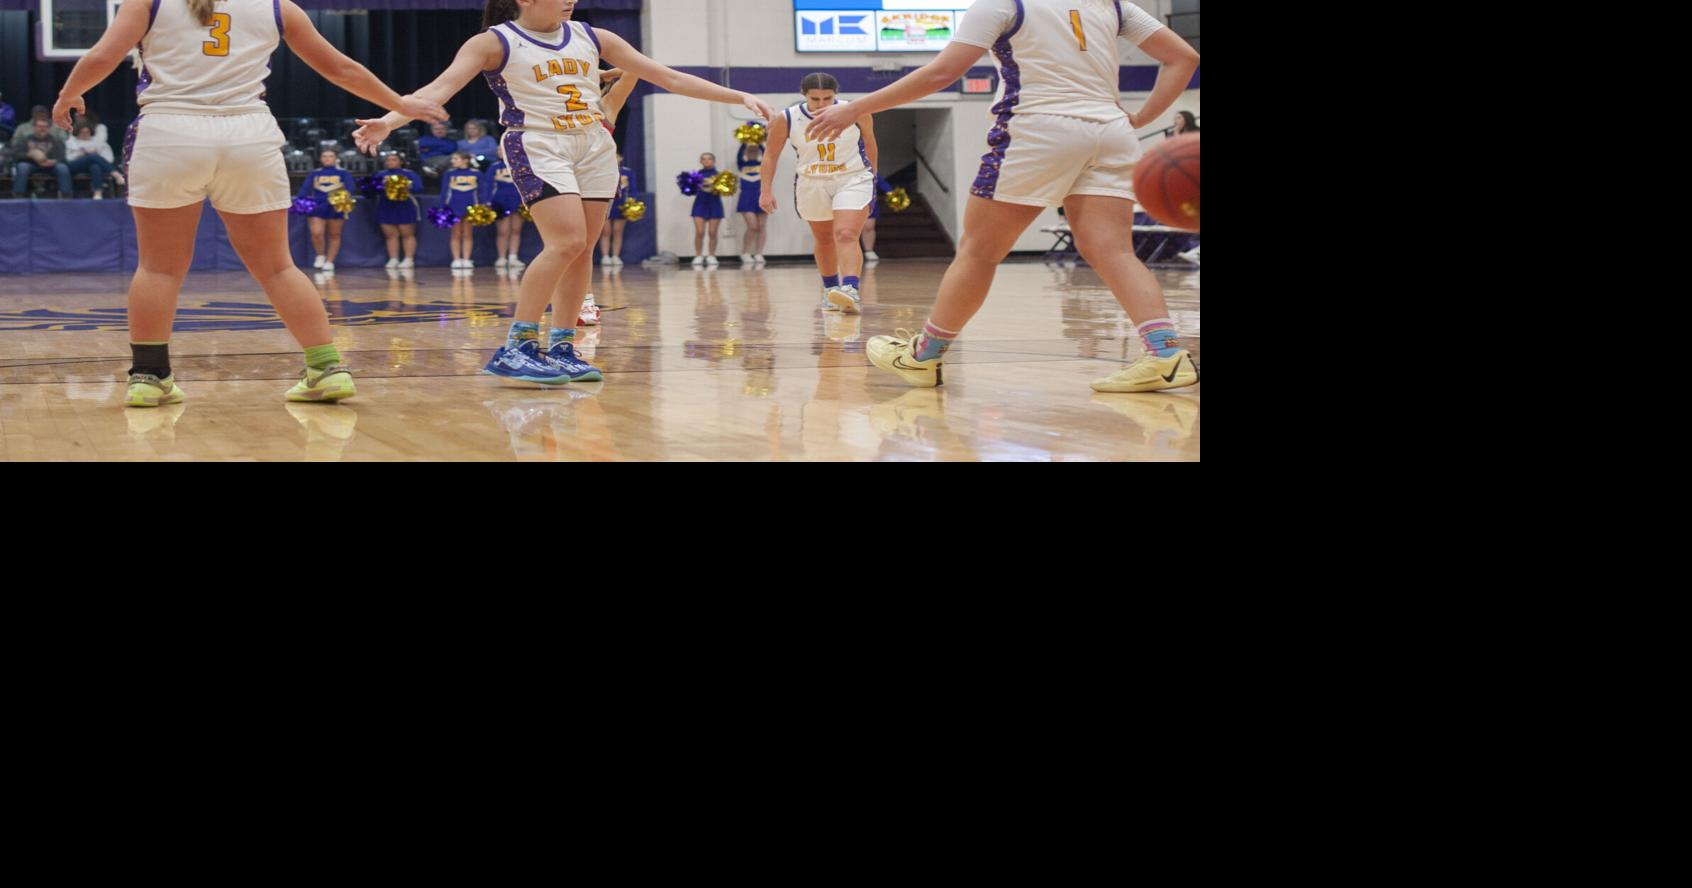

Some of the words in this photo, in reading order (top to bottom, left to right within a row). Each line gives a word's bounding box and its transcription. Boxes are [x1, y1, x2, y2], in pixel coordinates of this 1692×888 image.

[202, 13, 231, 56] 3
[1069, 9, 1088, 52] 1
[532, 58, 590, 82] LADY
[556, 84, 588, 111] 2
[817, 143, 835, 161] 11
